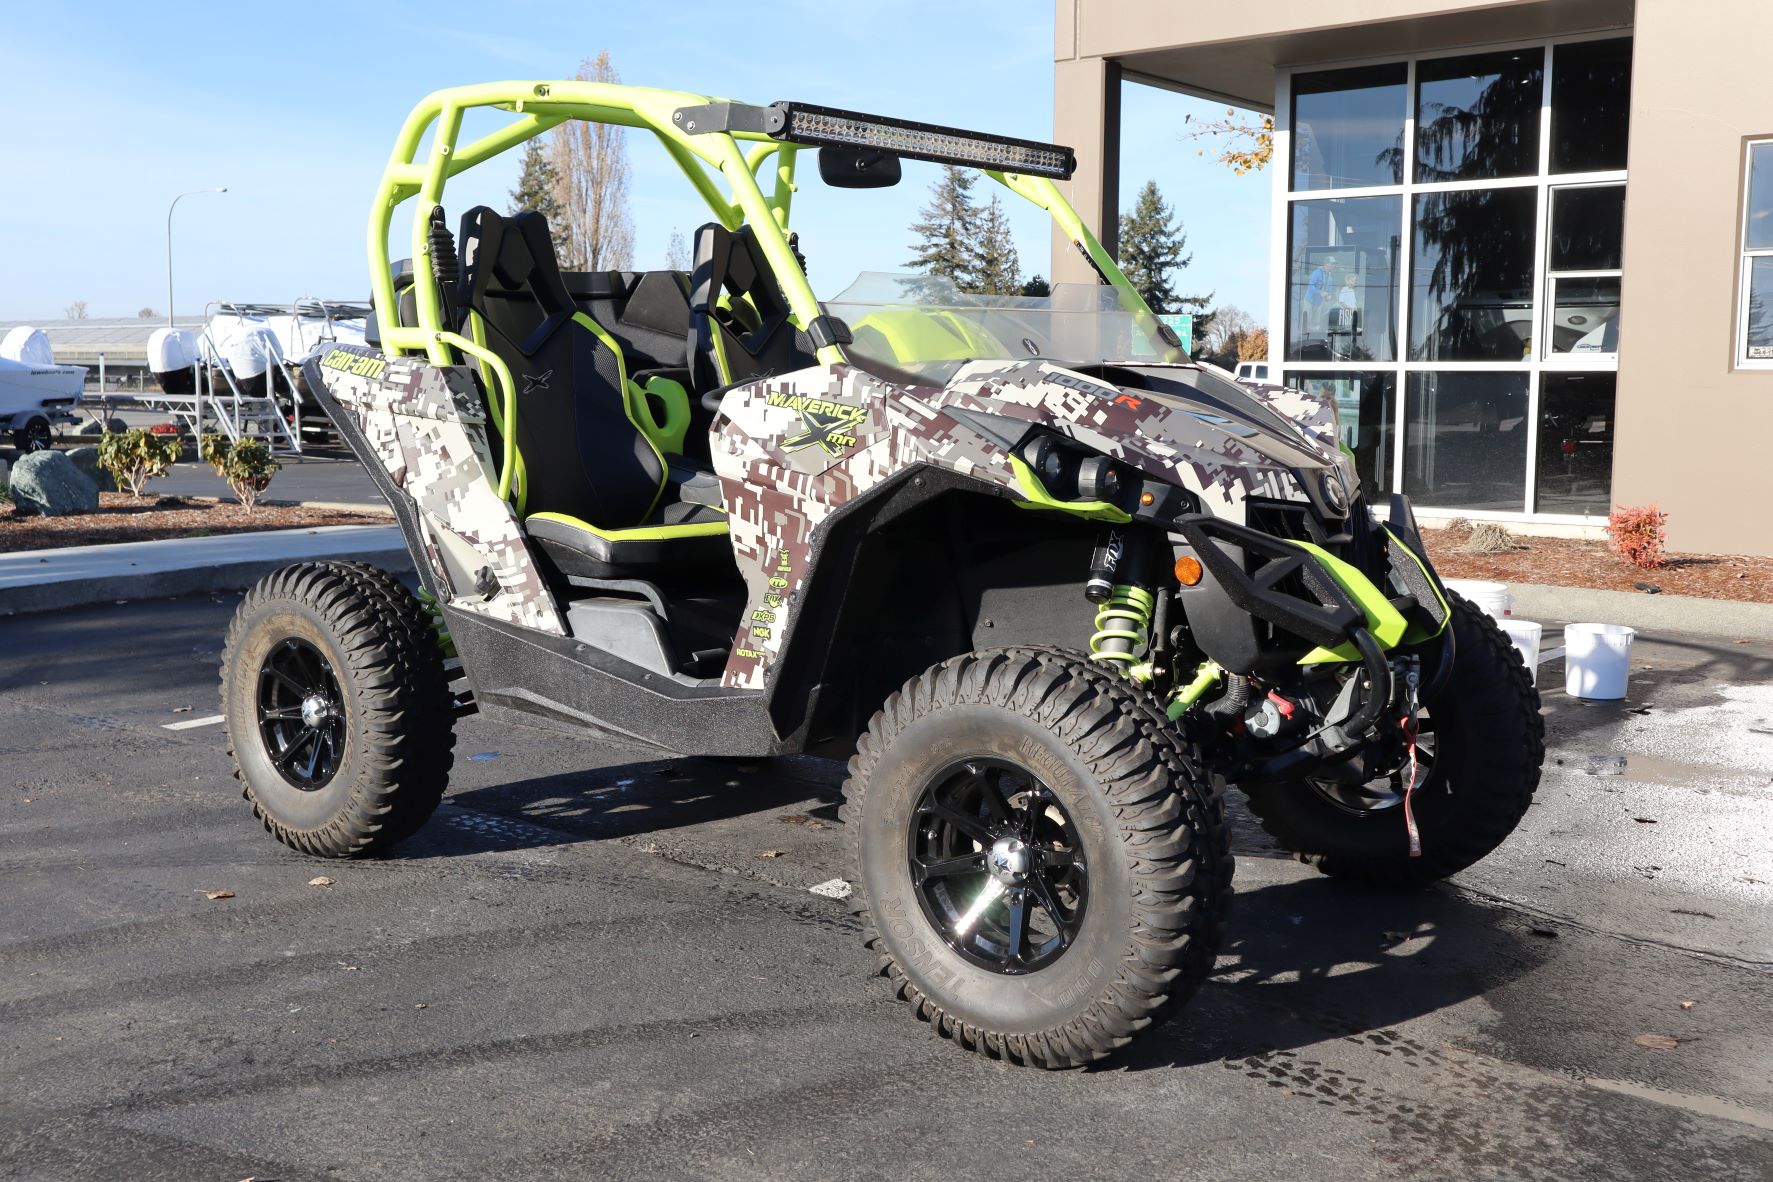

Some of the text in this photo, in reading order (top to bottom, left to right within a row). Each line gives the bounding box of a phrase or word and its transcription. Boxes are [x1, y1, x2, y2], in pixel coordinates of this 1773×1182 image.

[322, 349, 386, 380] can-am
[767, 391, 868, 423] MAVERICK
[753, 626, 771, 639] NGK
[736, 648, 759, 658] ROTAX
